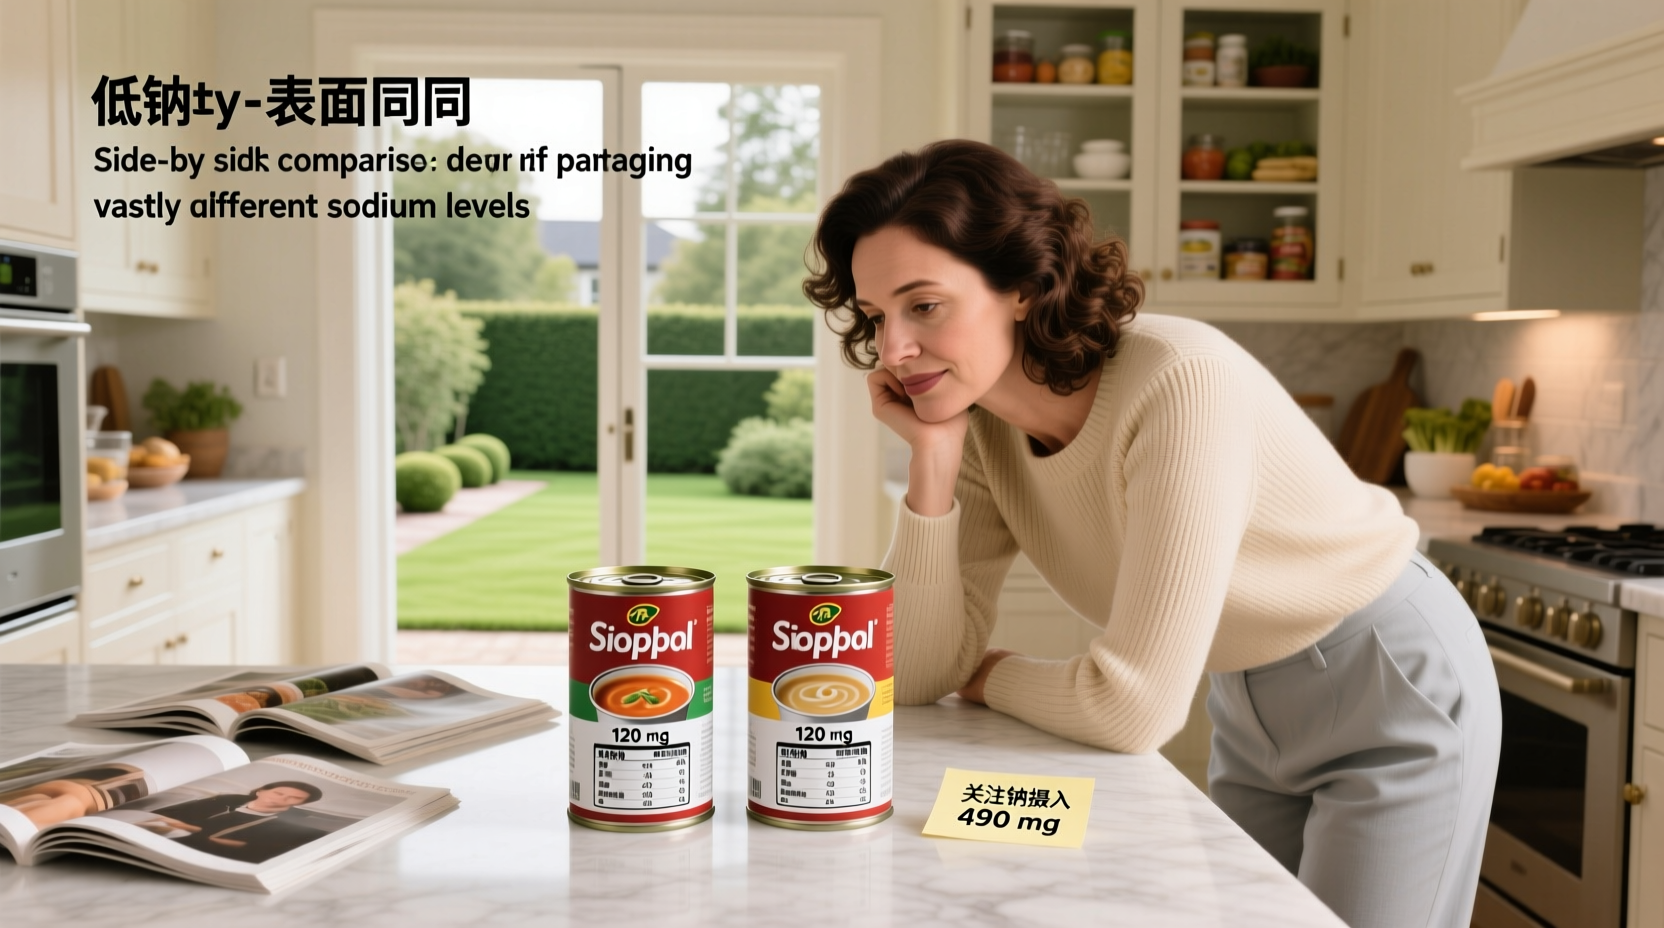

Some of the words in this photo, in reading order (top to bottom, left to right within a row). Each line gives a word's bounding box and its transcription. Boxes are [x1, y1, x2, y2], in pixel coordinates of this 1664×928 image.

[612, 727, 641, 743] 120
[646, 731, 669, 746] mg
[795, 726, 825, 742] 120
[830, 730, 853, 745] mg
[961, 783, 1071, 810] 关注钠摄入
[957, 808, 1011, 828] 490
[1017, 816, 1061, 836] mg
